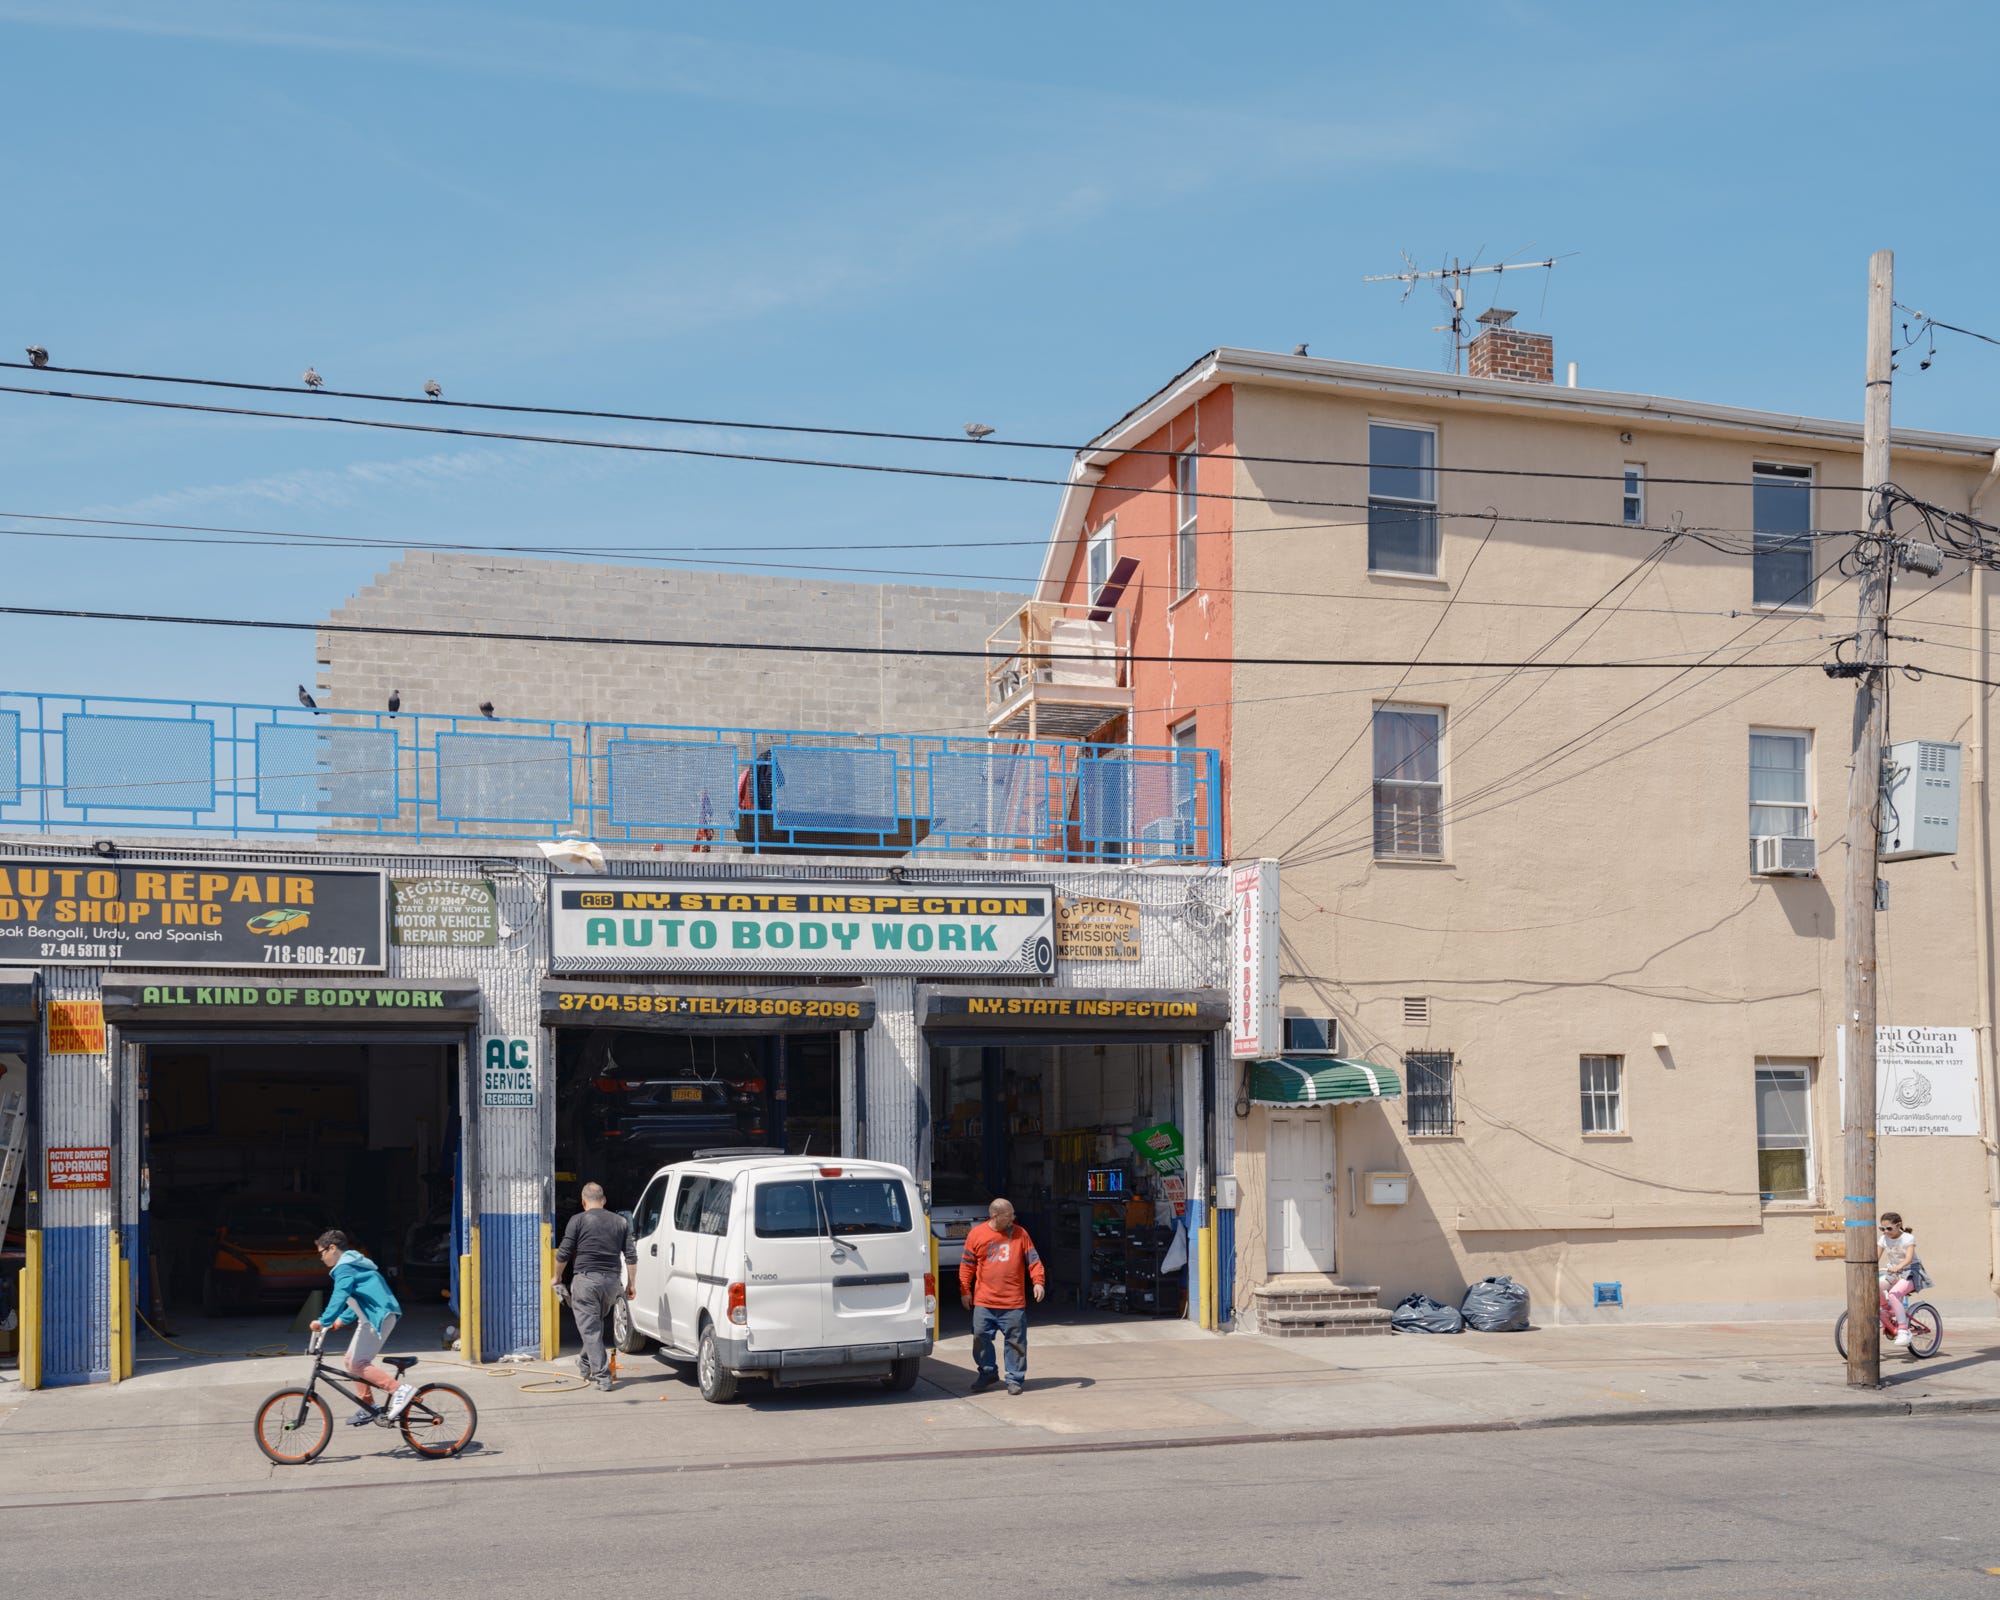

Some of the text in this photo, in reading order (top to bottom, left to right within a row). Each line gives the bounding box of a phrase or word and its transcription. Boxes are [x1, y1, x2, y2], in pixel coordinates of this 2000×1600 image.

[135, 872, 314, 904] REPAIR
[395, 880, 489, 904] REGISTERED
[55, 900, 150, 924] SHOP
[161, 903, 222, 926] INC
[582, 895, 613, 906] A&B
[680, 894, 798, 911] STATE
[809, 896, 1028, 915] INSPECTION
[1060, 902, 1132, 920] OFFICIAL
[395, 915, 491, 928] MOTOR VEHICLE
[1243, 892, 1252, 962] AUTO
[28, 925, 88, 941] Bengali,
[93, 927, 130, 941] Urdu,
[135, 929, 162, 940] and
[167, 929, 223, 943] Spanish
[403, 930, 485, 942] REPAIR SHOP
[586, 917, 998, 952] AUTO BODY WORK
[1062, 930, 1130, 942] EMISSIONS
[41, 943, 122, 957] 37-04 58TH ST
[263, 945, 365, 965] 718-606-2067
[1105, 945, 1137, 957] STAION
[143, 986, 444, 1008] ALL KIND OF BODY WORK
[1243, 967, 1252, 1036] BODY
[52, 1004, 99, 1026] HEADLIGHT
[968, 998, 1197, 1017] N.Y. STATE INSPECTION
[50, 1029, 104, 1050] RESTORATION
[1908, 1029, 1958, 1044] Quran
[486, 1039, 532, 1069] A.C.
[1879, 1042, 1954, 1054] asSunnah
[486, 1073, 532, 1089] SERVICE
[487, 1094, 531, 1104] RECHARGE
[50, 1150, 108, 1160] ACTIVE DRIVEWAY
[52, 1173, 106, 1183] 24 HRS.
